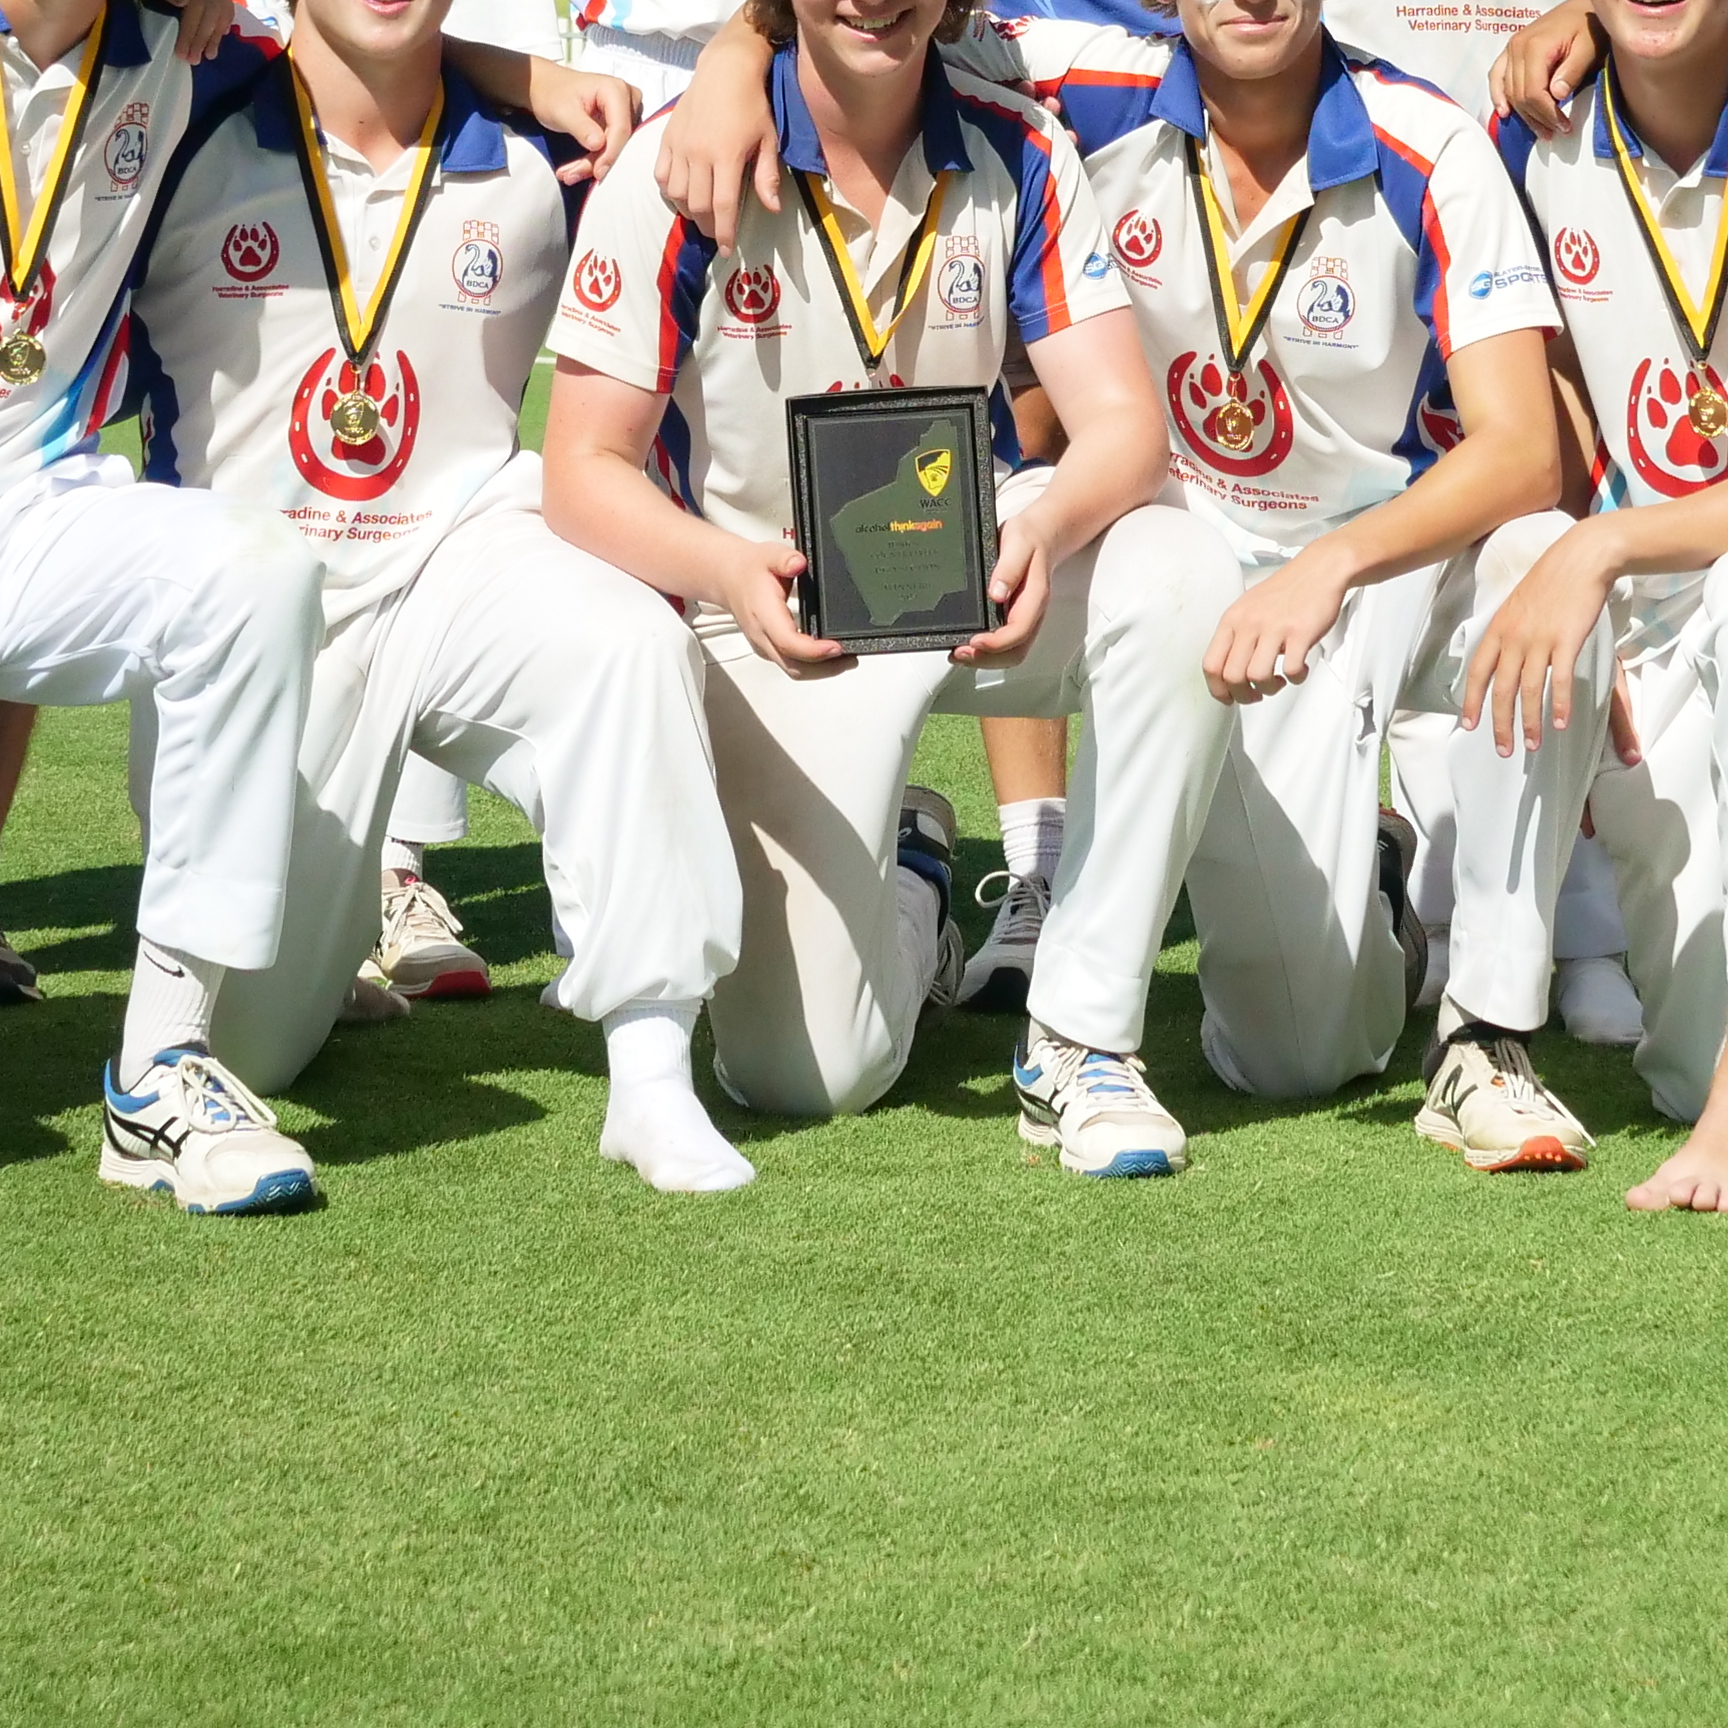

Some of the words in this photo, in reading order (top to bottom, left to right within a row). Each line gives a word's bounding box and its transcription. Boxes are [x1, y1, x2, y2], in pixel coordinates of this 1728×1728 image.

[1396, 4, 1459, 18] Harradine
[1463, 5, 1472, 17] &
[1475, 4, 1542, 20] Associates
[1408, 20, 1471, 34] Veterinary
[1474, 19, 1525, 34] Surgeon
[952, 296, 978, 304] BDCA
[1312, 315, 1339, 324] BDCA
[1231, 482, 1320, 503] Associates
[1231, 492, 1308, 511] Surgeons
[335, 511, 348, 524] &
